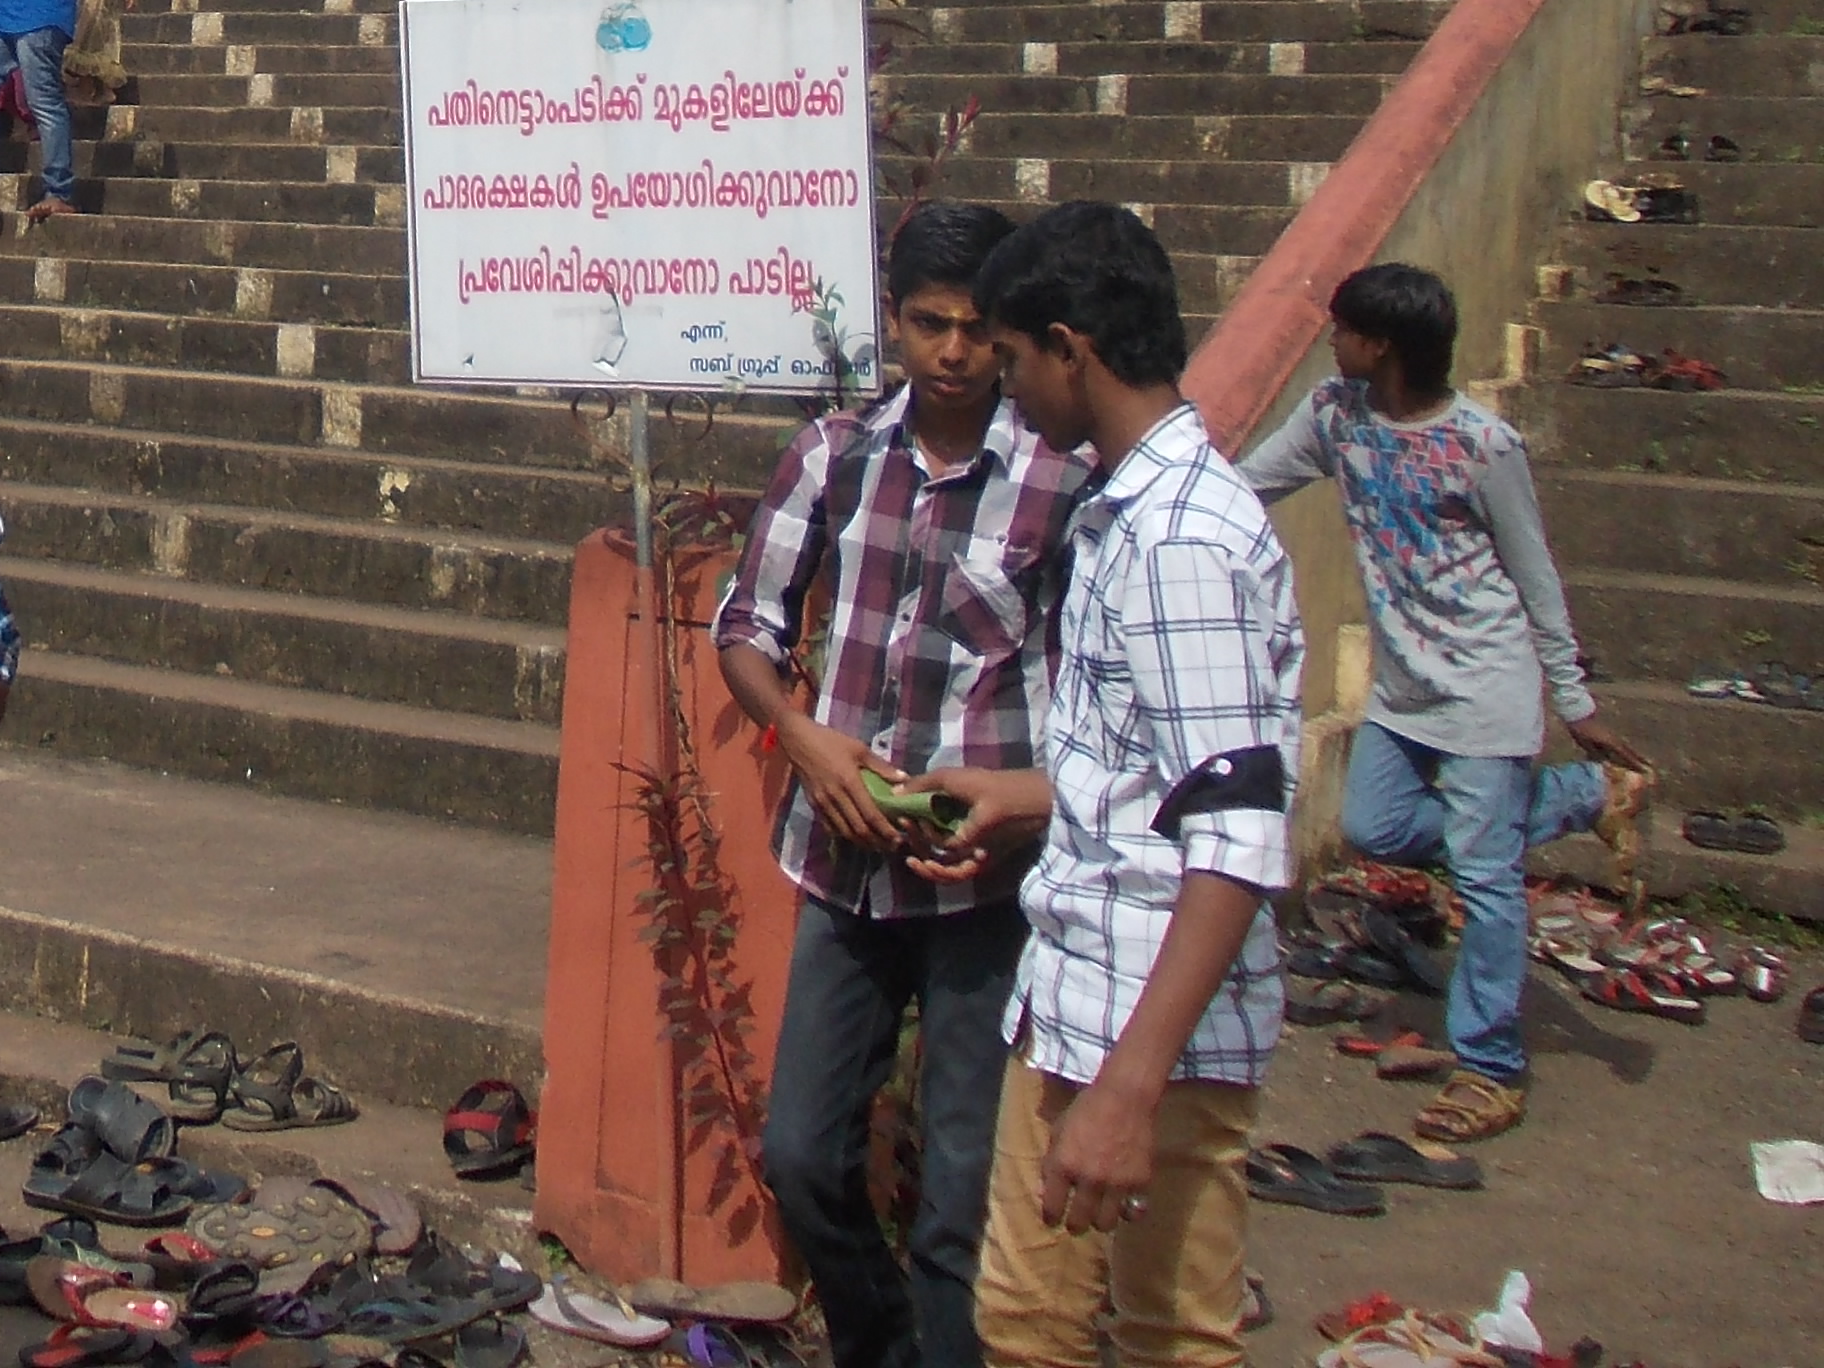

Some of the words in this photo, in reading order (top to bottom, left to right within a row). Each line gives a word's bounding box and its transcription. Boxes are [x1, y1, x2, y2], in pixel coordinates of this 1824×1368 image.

[428, 72, 647, 136] പതിനെട്ടാംപടിക്ക്
[653, 65, 849, 133] മുകളിലേയ്ക്ക്
[423, 160, 582, 210] പാദരക്ഷകൾ
[591, 158, 860, 220] ഉപയോഗിക്കുവാനോ
[458, 245, 720, 307] പ്രവേശിപ്പിക്കുവാനോ
[728, 245, 815, 313] പാടില്ല
[689, 353, 734, 373] സബ്
